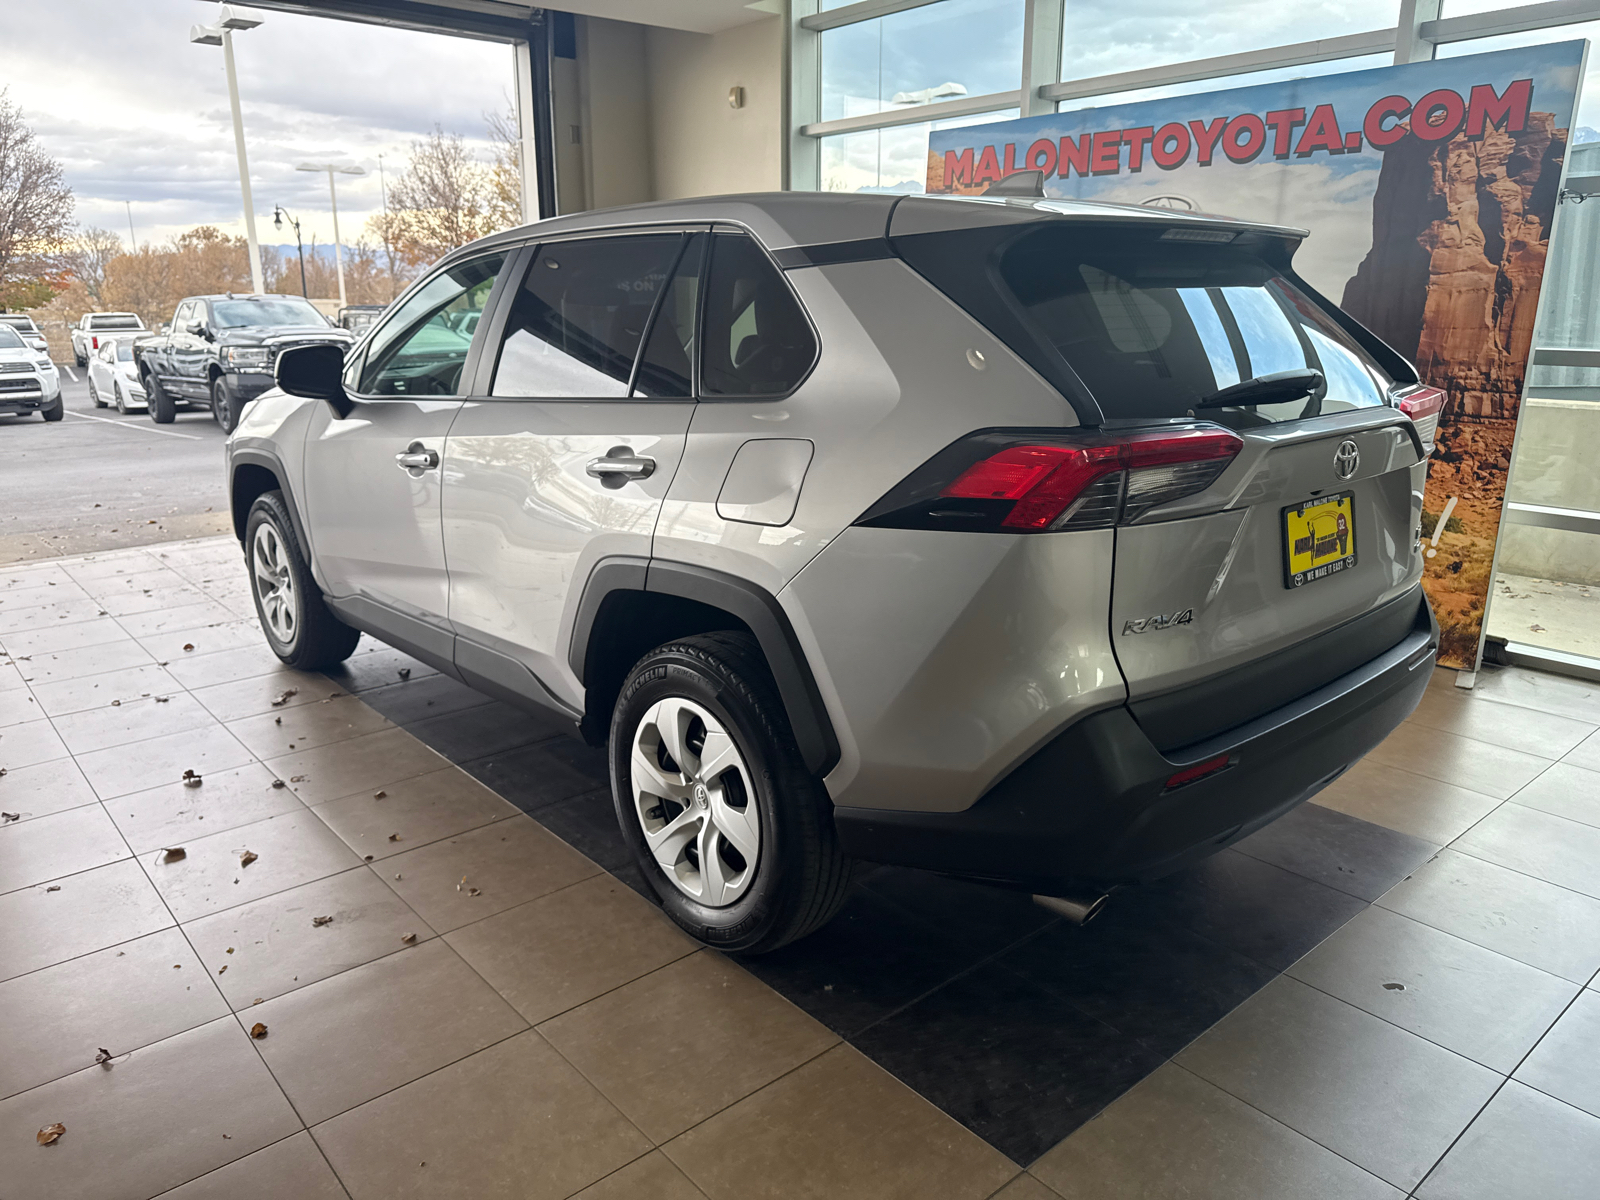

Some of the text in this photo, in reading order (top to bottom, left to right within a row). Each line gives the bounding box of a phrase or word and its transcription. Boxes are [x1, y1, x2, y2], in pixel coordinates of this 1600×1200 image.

[943, 78, 1534, 188] MALONETOYOTA.COM
[1338, 518, 1346, 530] 32
[1306, 560, 1344, 581] WE MAKE IT EASY
[1121, 607, 1194, 636] RAV4
[626, 665, 702, 701] MICHELIN PRIMACY
